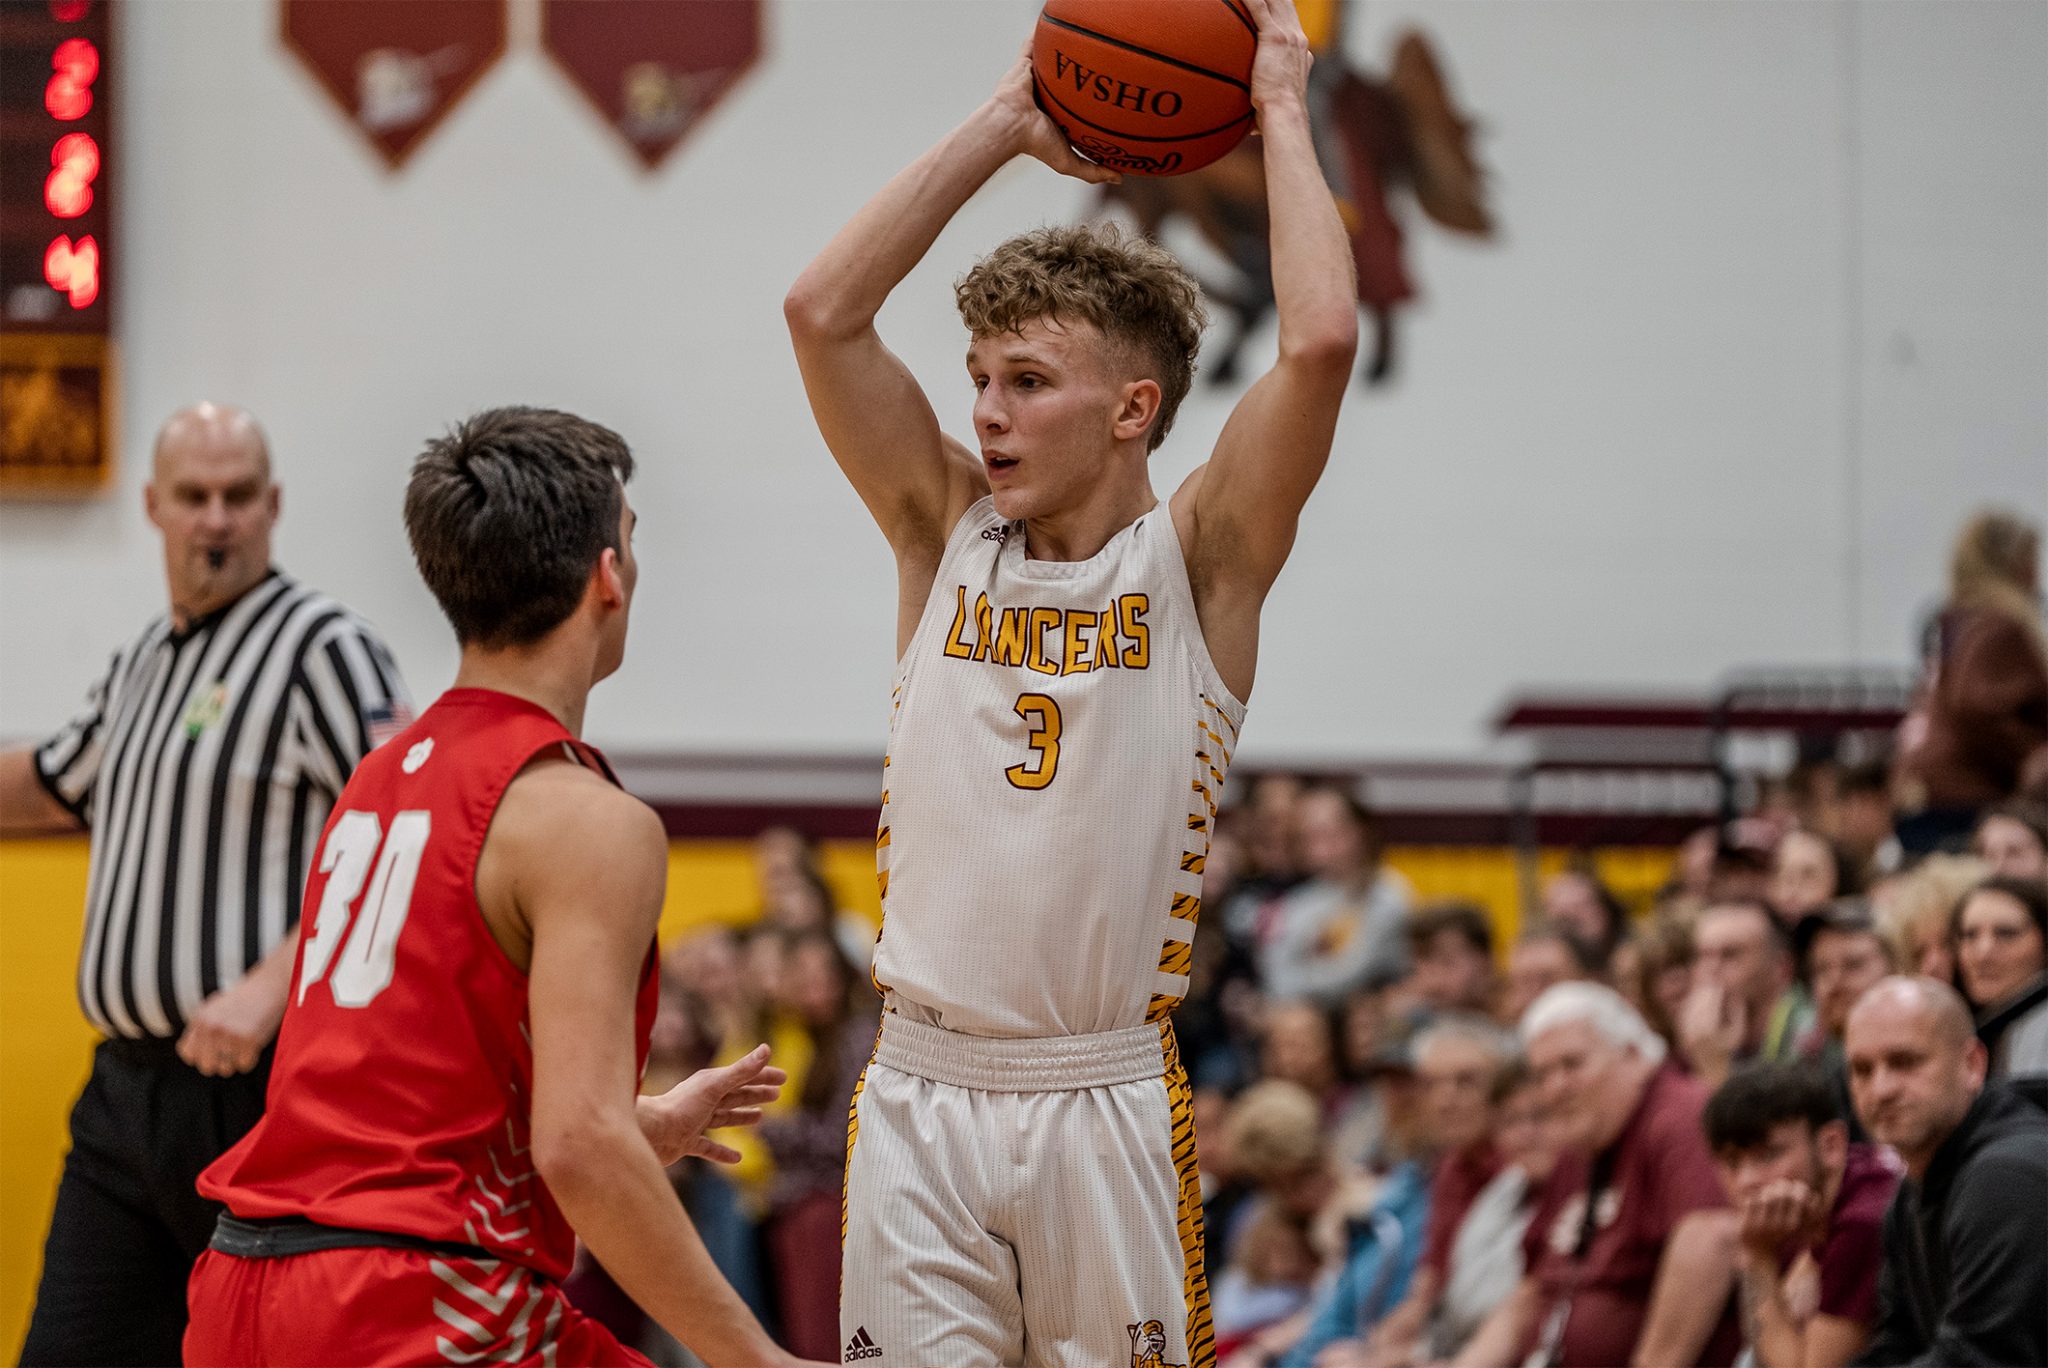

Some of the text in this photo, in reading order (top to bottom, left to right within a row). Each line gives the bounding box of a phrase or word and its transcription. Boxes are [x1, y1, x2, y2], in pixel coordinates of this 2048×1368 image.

[1054, 49, 1182, 117] OHSAA
[943, 585, 1150, 677] LANCERS
[1005, 692, 1063, 790] 3
[297, 808, 432, 1008] 30
[844, 1347, 883, 1362] adidas
